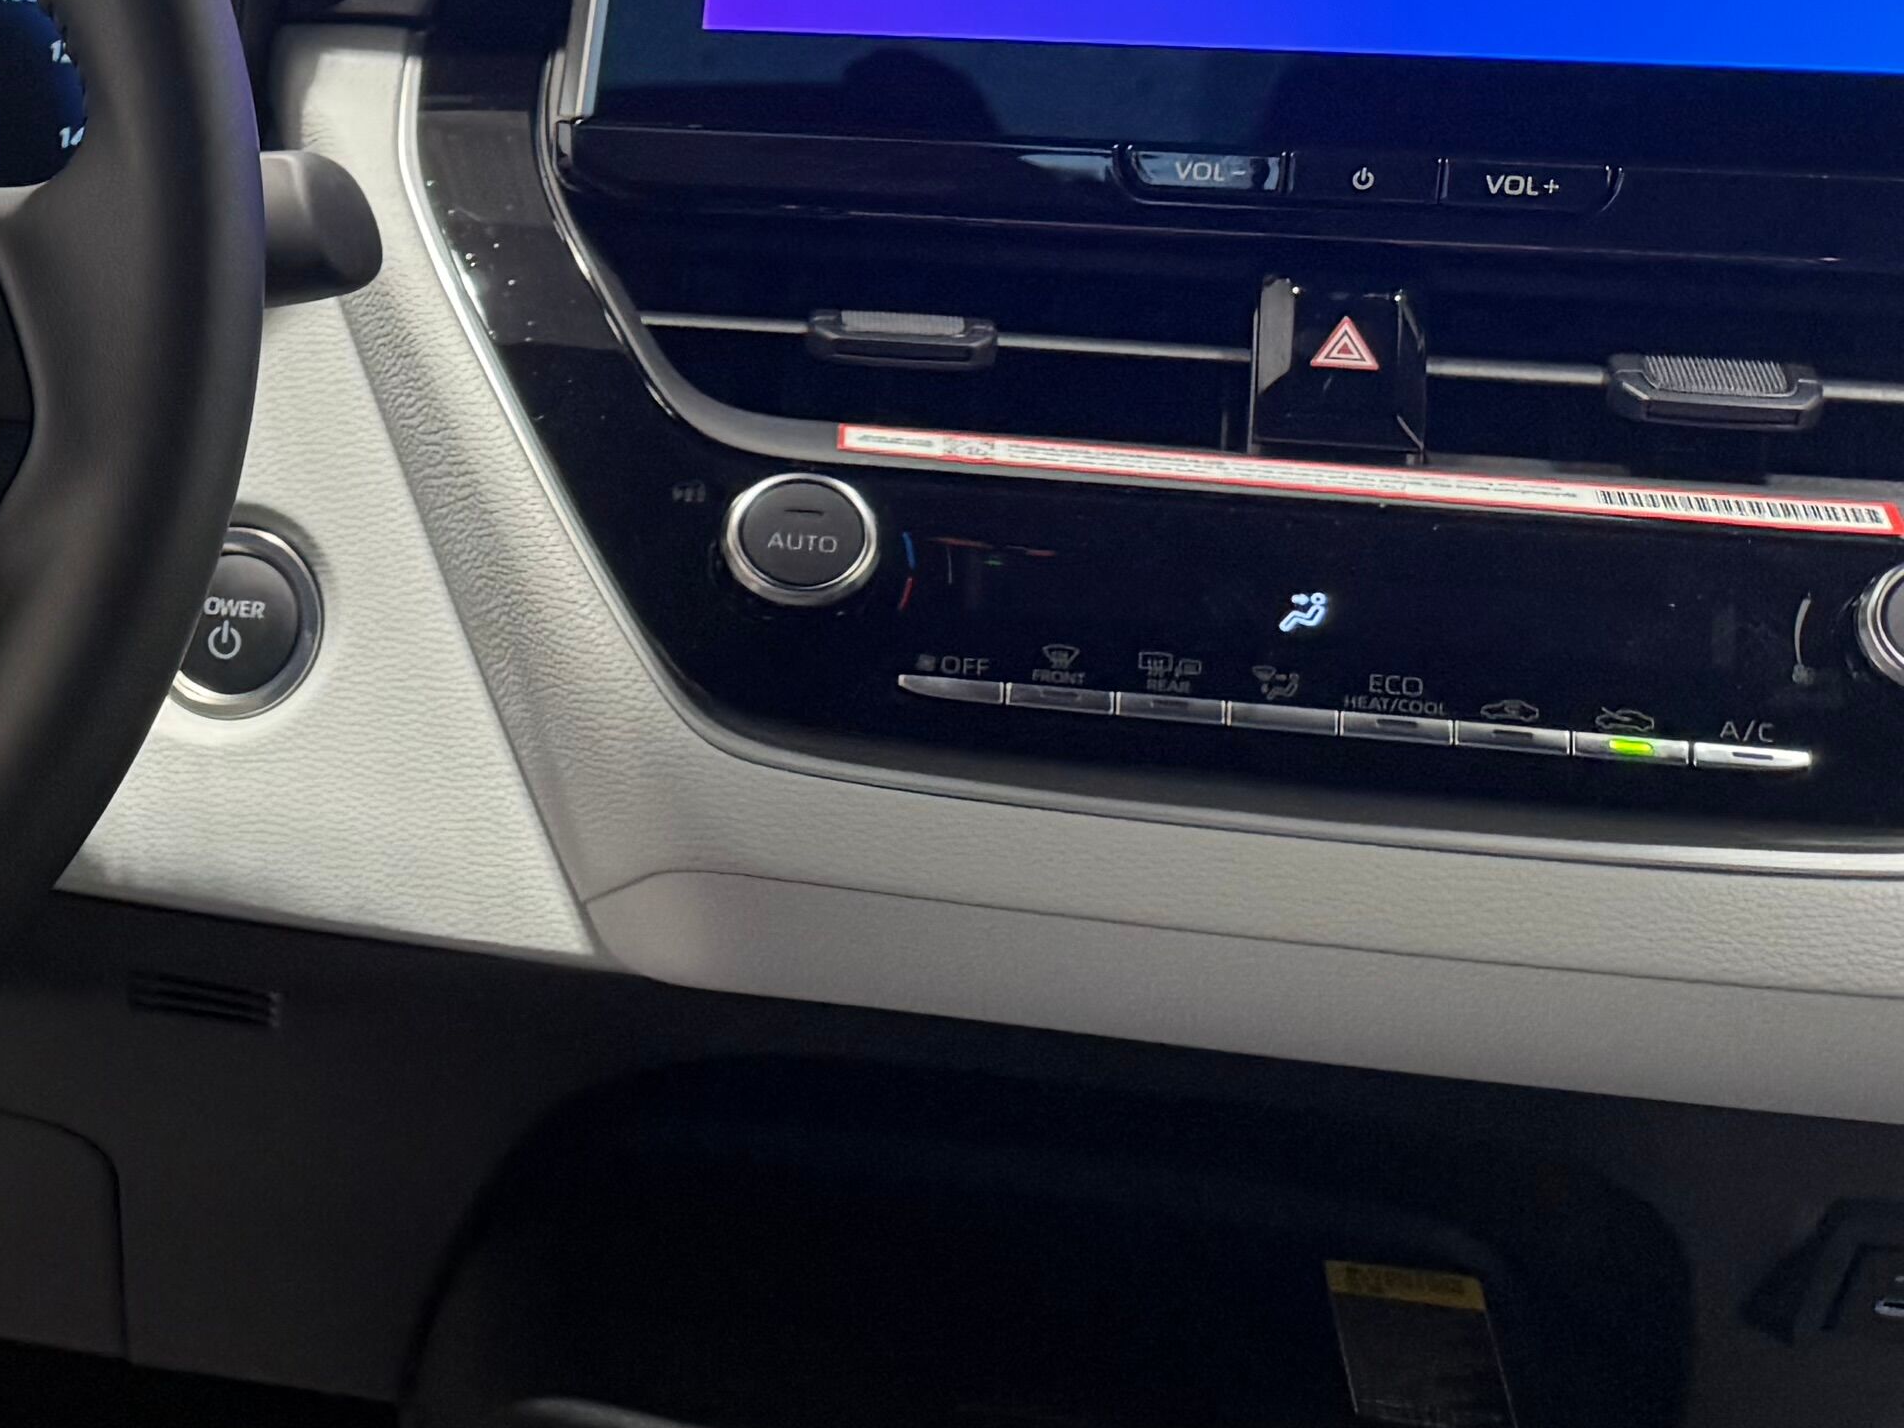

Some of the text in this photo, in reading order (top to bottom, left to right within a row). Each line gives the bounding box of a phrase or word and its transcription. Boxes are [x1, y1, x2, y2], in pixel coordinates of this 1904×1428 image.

[767, 532, 838, 554] AUTO
[203, 596, 267, 619] OWER
[940, 655, 989, 675] OFF
[1032, 668, 1085, 685] FRONT
[1146, 678, 1190, 693] REAR
[1368, 673, 1423, 698] ECO
[1343, 695, 1447, 717] HEAT/COOL
[1720, 720, 1775, 744] A/C
